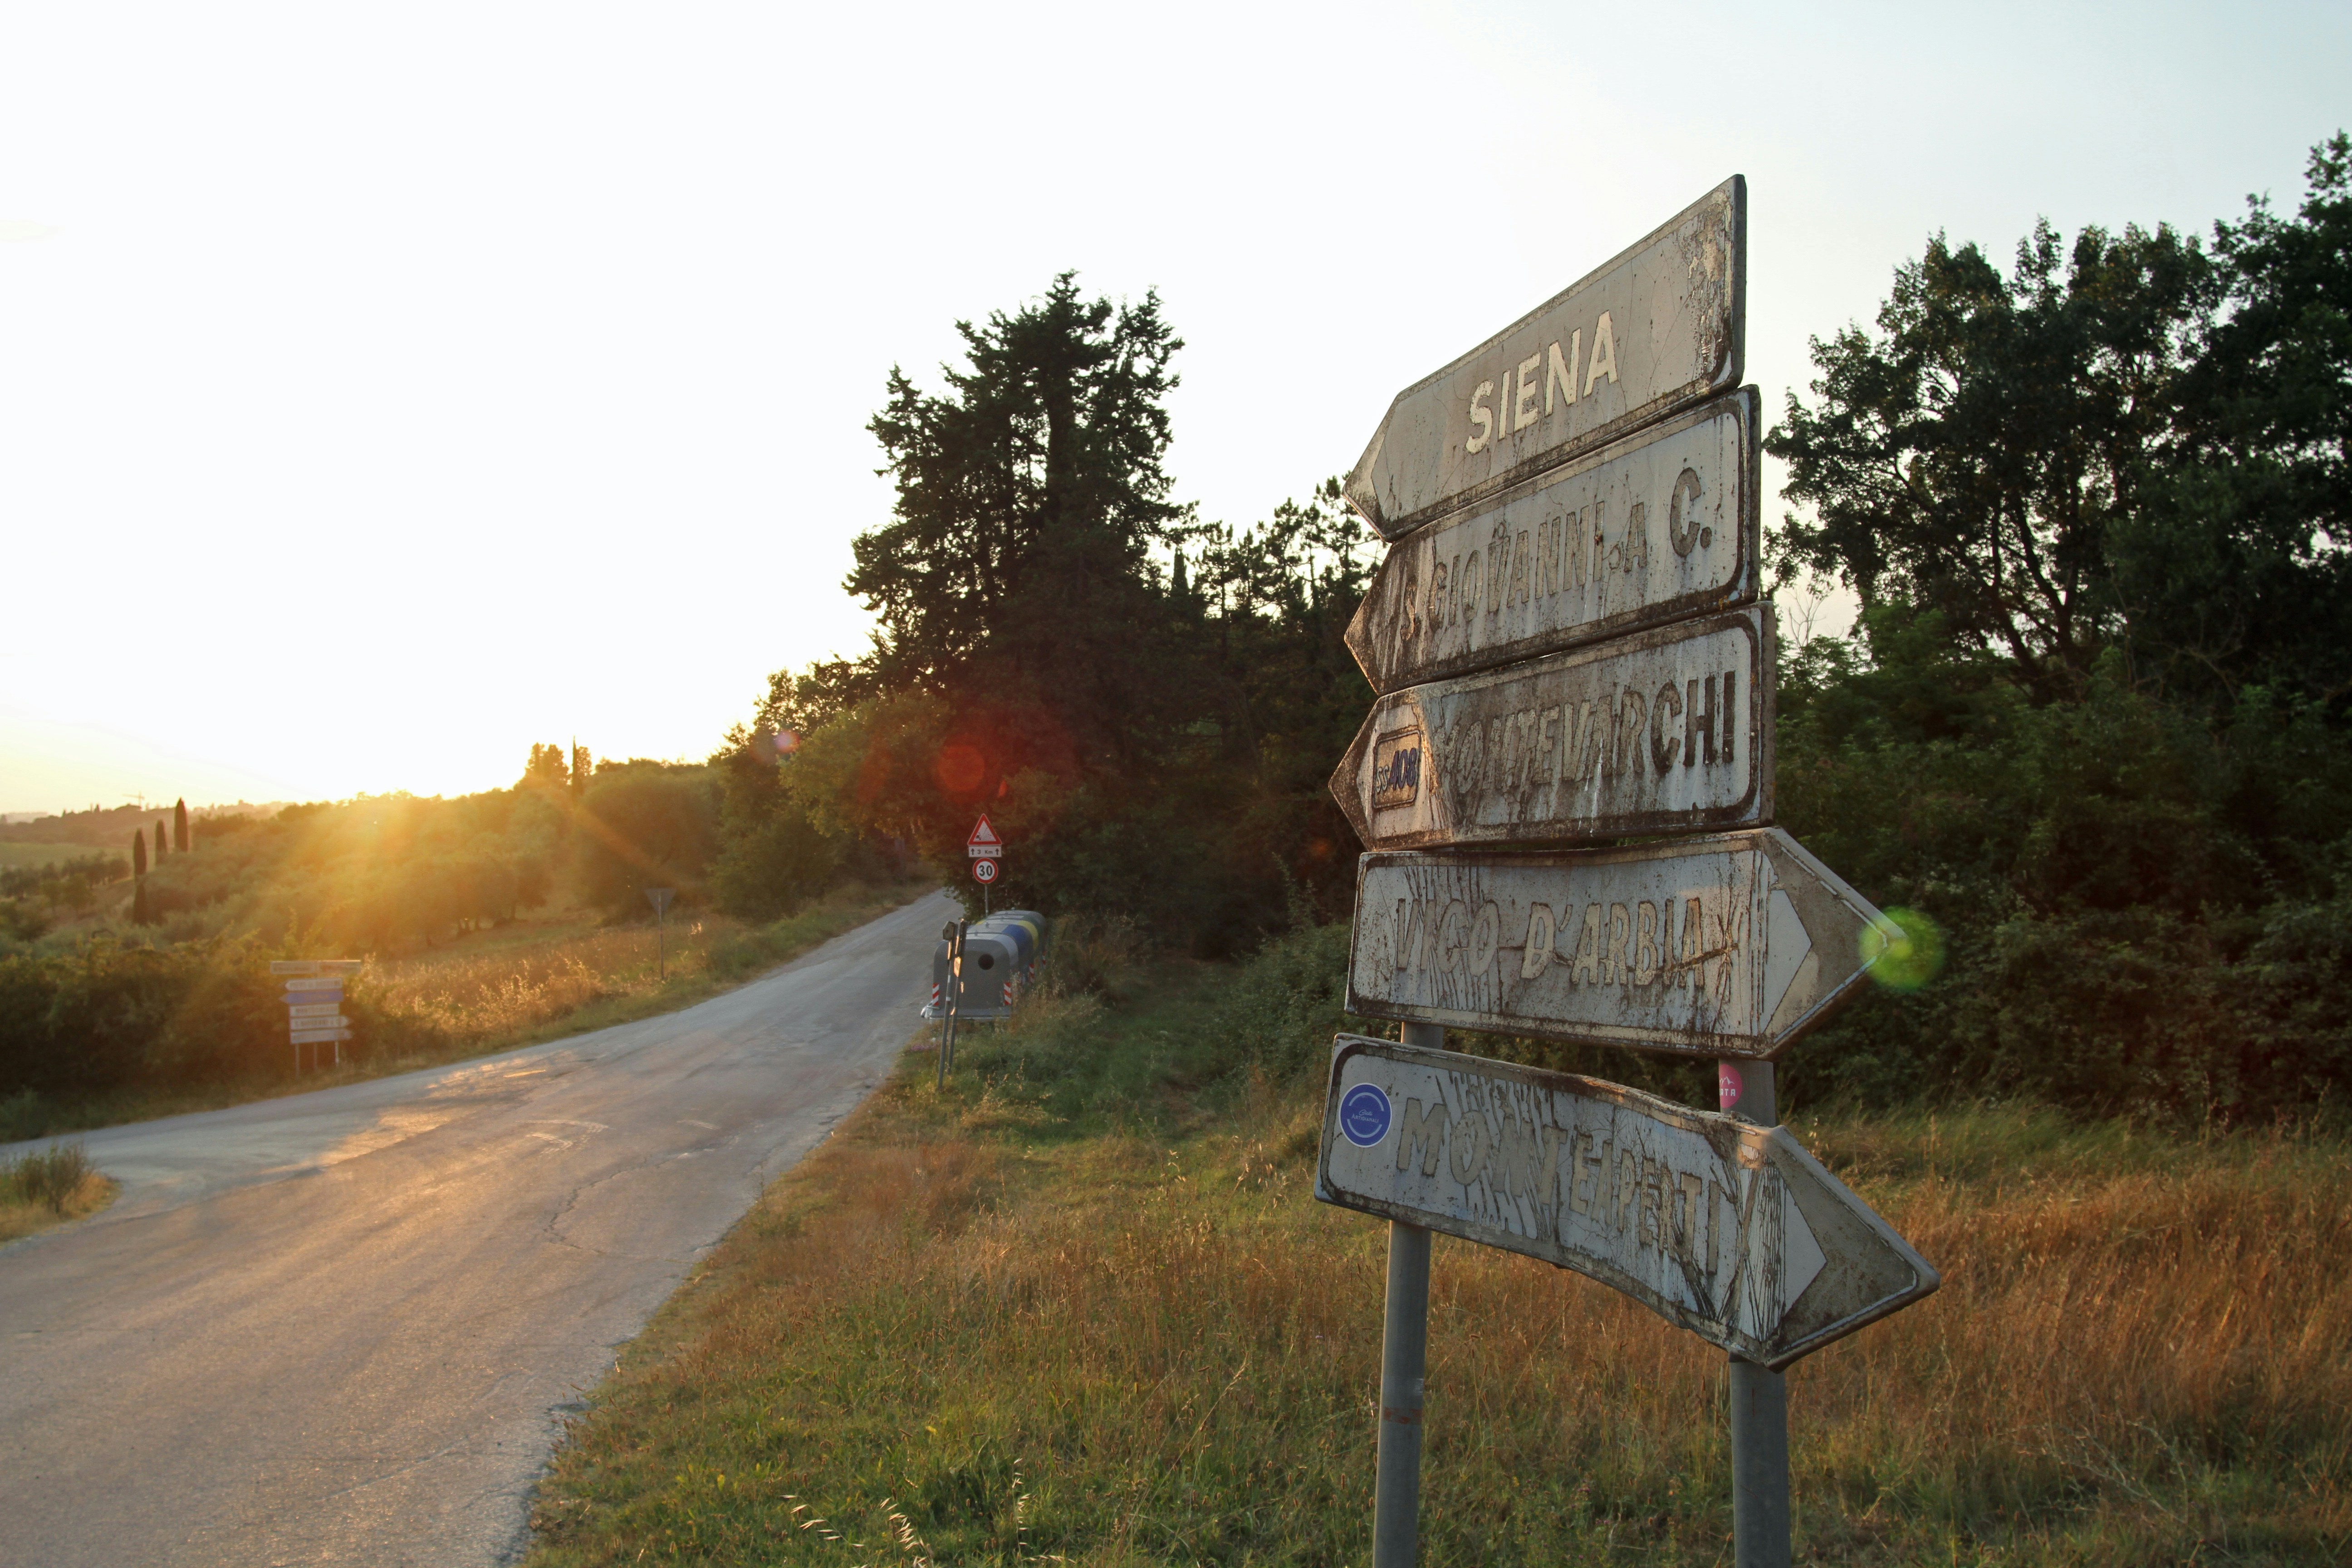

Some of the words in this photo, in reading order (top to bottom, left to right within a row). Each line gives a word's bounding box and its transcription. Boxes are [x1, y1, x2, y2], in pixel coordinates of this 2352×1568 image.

[1465, 310, 1618, 454] SIENA
[1429, 500, 1604, 631] GIOVANNI
[1624, 502, 1647, 572] A
[1670, 467, 1712, 558] C.
[1389, 748, 1417, 790] 408
[1432, 671, 1735, 795] MONTEVARCHI
[979, 865, 993, 877] 30
[1397, 899, 1500, 977] VICO
[1520, 898, 1705, 989] D'ARBIA
[1396, 1097, 1720, 1275] MONTEAPERTI
